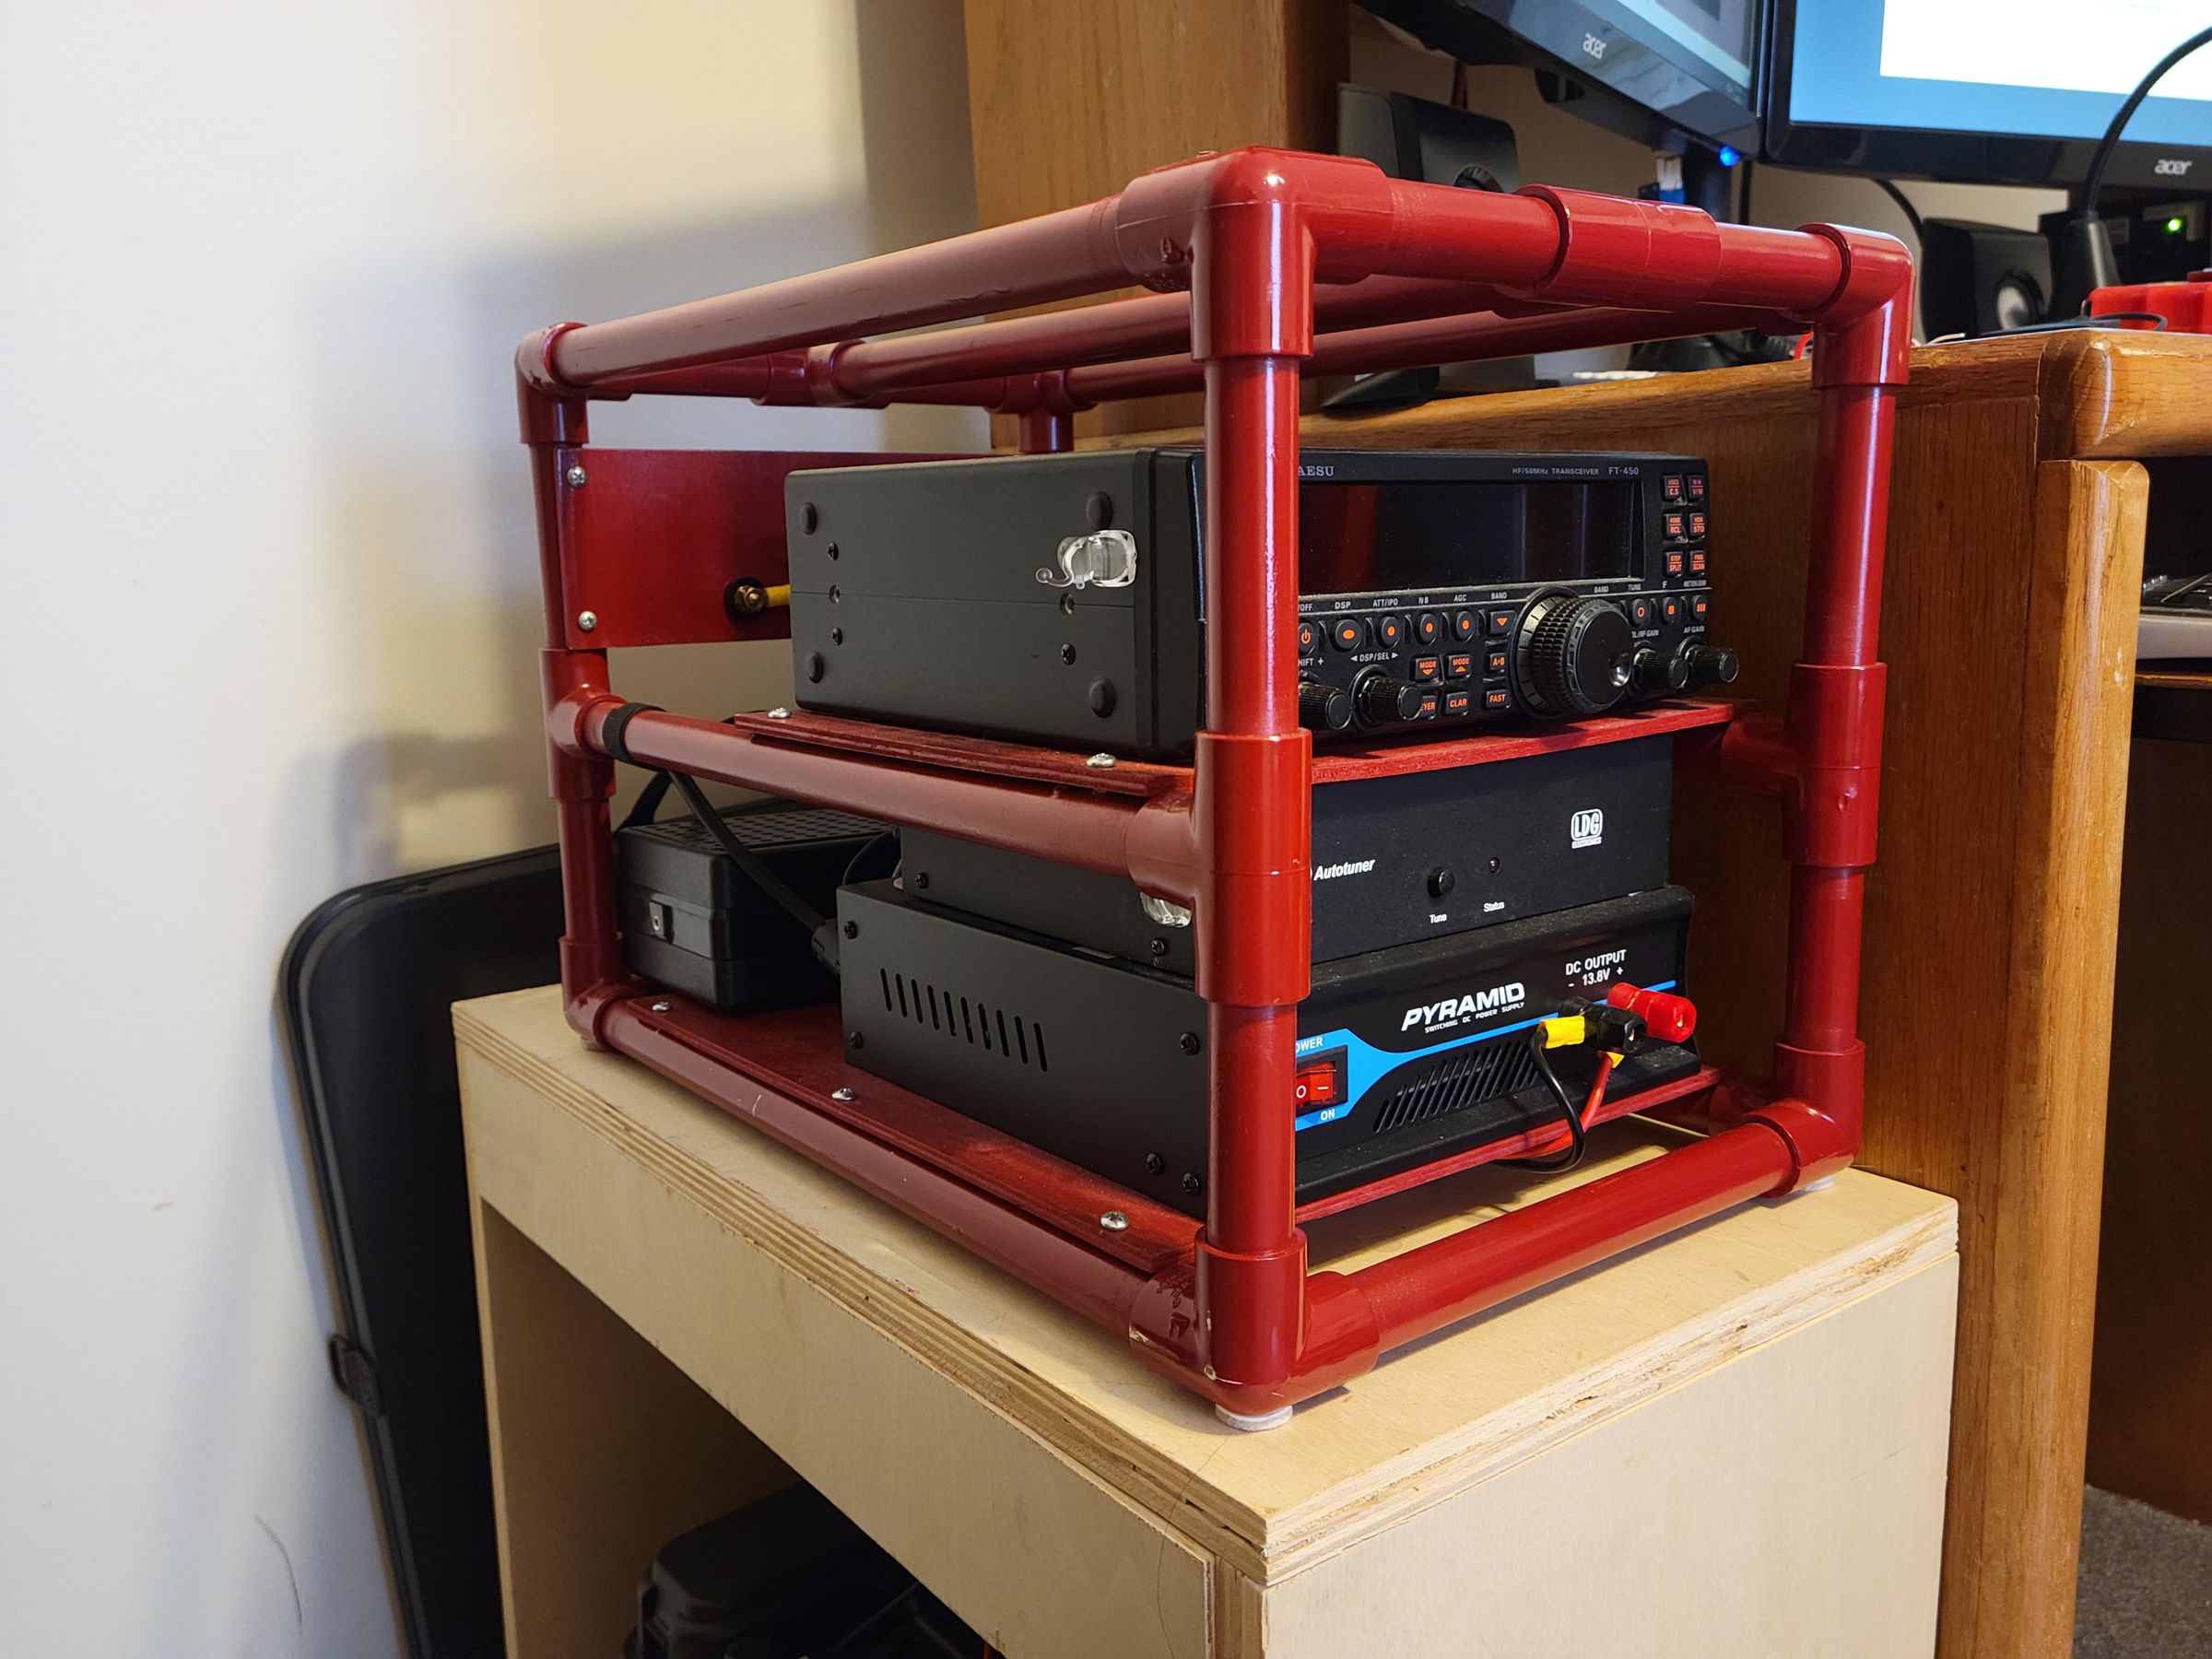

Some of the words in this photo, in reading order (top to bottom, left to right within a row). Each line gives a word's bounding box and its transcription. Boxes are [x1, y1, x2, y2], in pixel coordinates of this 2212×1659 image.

[1583, 33, 1606, 60] acer
[2154, 159, 2193, 176] acer
[1608, 466, 1639, 476] FT-450
[1594, 585, 1609, 594] BAND
[1662, 581, 1668, 589] F
[1453, 594, 1467, 602] AGC
[1490, 592, 1508, 600] BAND
[1335, 601, 1351, 609] DSP
[1372, 598, 1398, 607] ATT/IPO
[1359, 652, 1390, 662] DSP/SEL
[1453, 657, 1470, 666] MODE
[1419, 660, 1437, 669] MODE
[1450, 698, 1467, 708] CLAR
[1489, 693, 1506, 703] FAST
[1574, 812, 1600, 838] LDG
[1313, 859, 1376, 881] Autotuner
[1483, 901, 1505, 912] Status
[1429, 913, 1448, 924] Tune
[1565, 960, 1582, 975] DC
[1584, 949, 1627, 971] OUTPUT
[1582, 968, 1611, 986] 13.8V
[1401, 982, 1525, 1031] PYRAMID
[1424, 1019, 1458, 1033] SWITCHING
[1475, 1009, 1498, 1019] POWER
[1501, 1002, 1524, 1013] SUPPLY
[1320, 1108, 1335, 1121] ON
